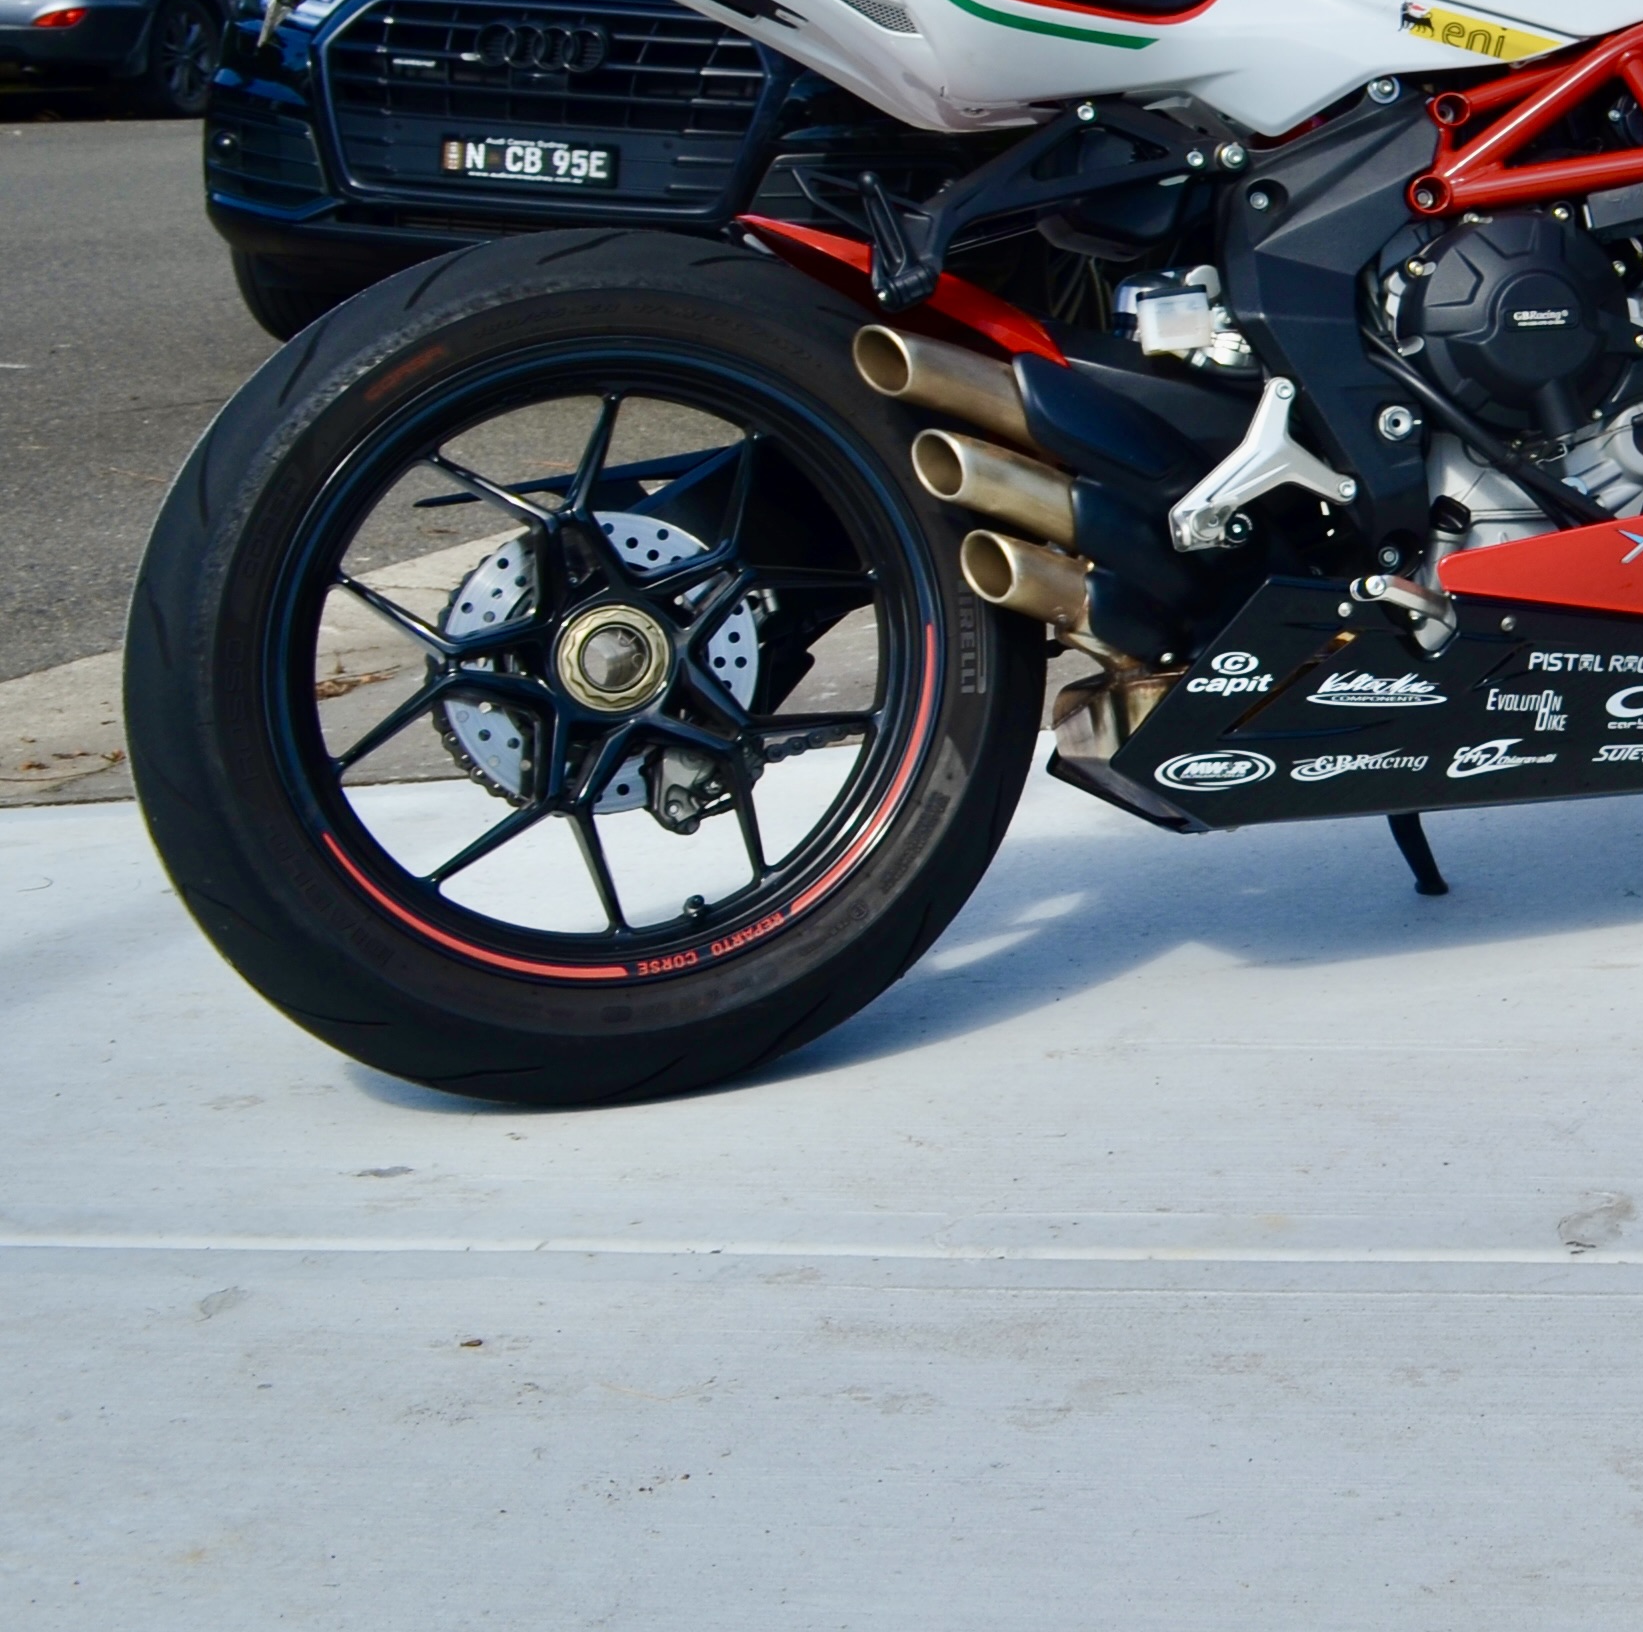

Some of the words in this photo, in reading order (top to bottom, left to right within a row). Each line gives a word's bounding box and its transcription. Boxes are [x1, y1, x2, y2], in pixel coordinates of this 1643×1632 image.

[1441, 20, 1507, 60] eni
[465, 142, 486, 169] N
[505, 146, 543, 174] CB
[552, 149, 608, 179] 95E
[1186, 673, 1275, 697] capit
[1330, 694, 1423, 704] COMPONENTS
[1315, 754, 1429, 773] GBRacing
[710, 912, 786, 957] REPARTO
[636, 950, 700, 977] CORSE
